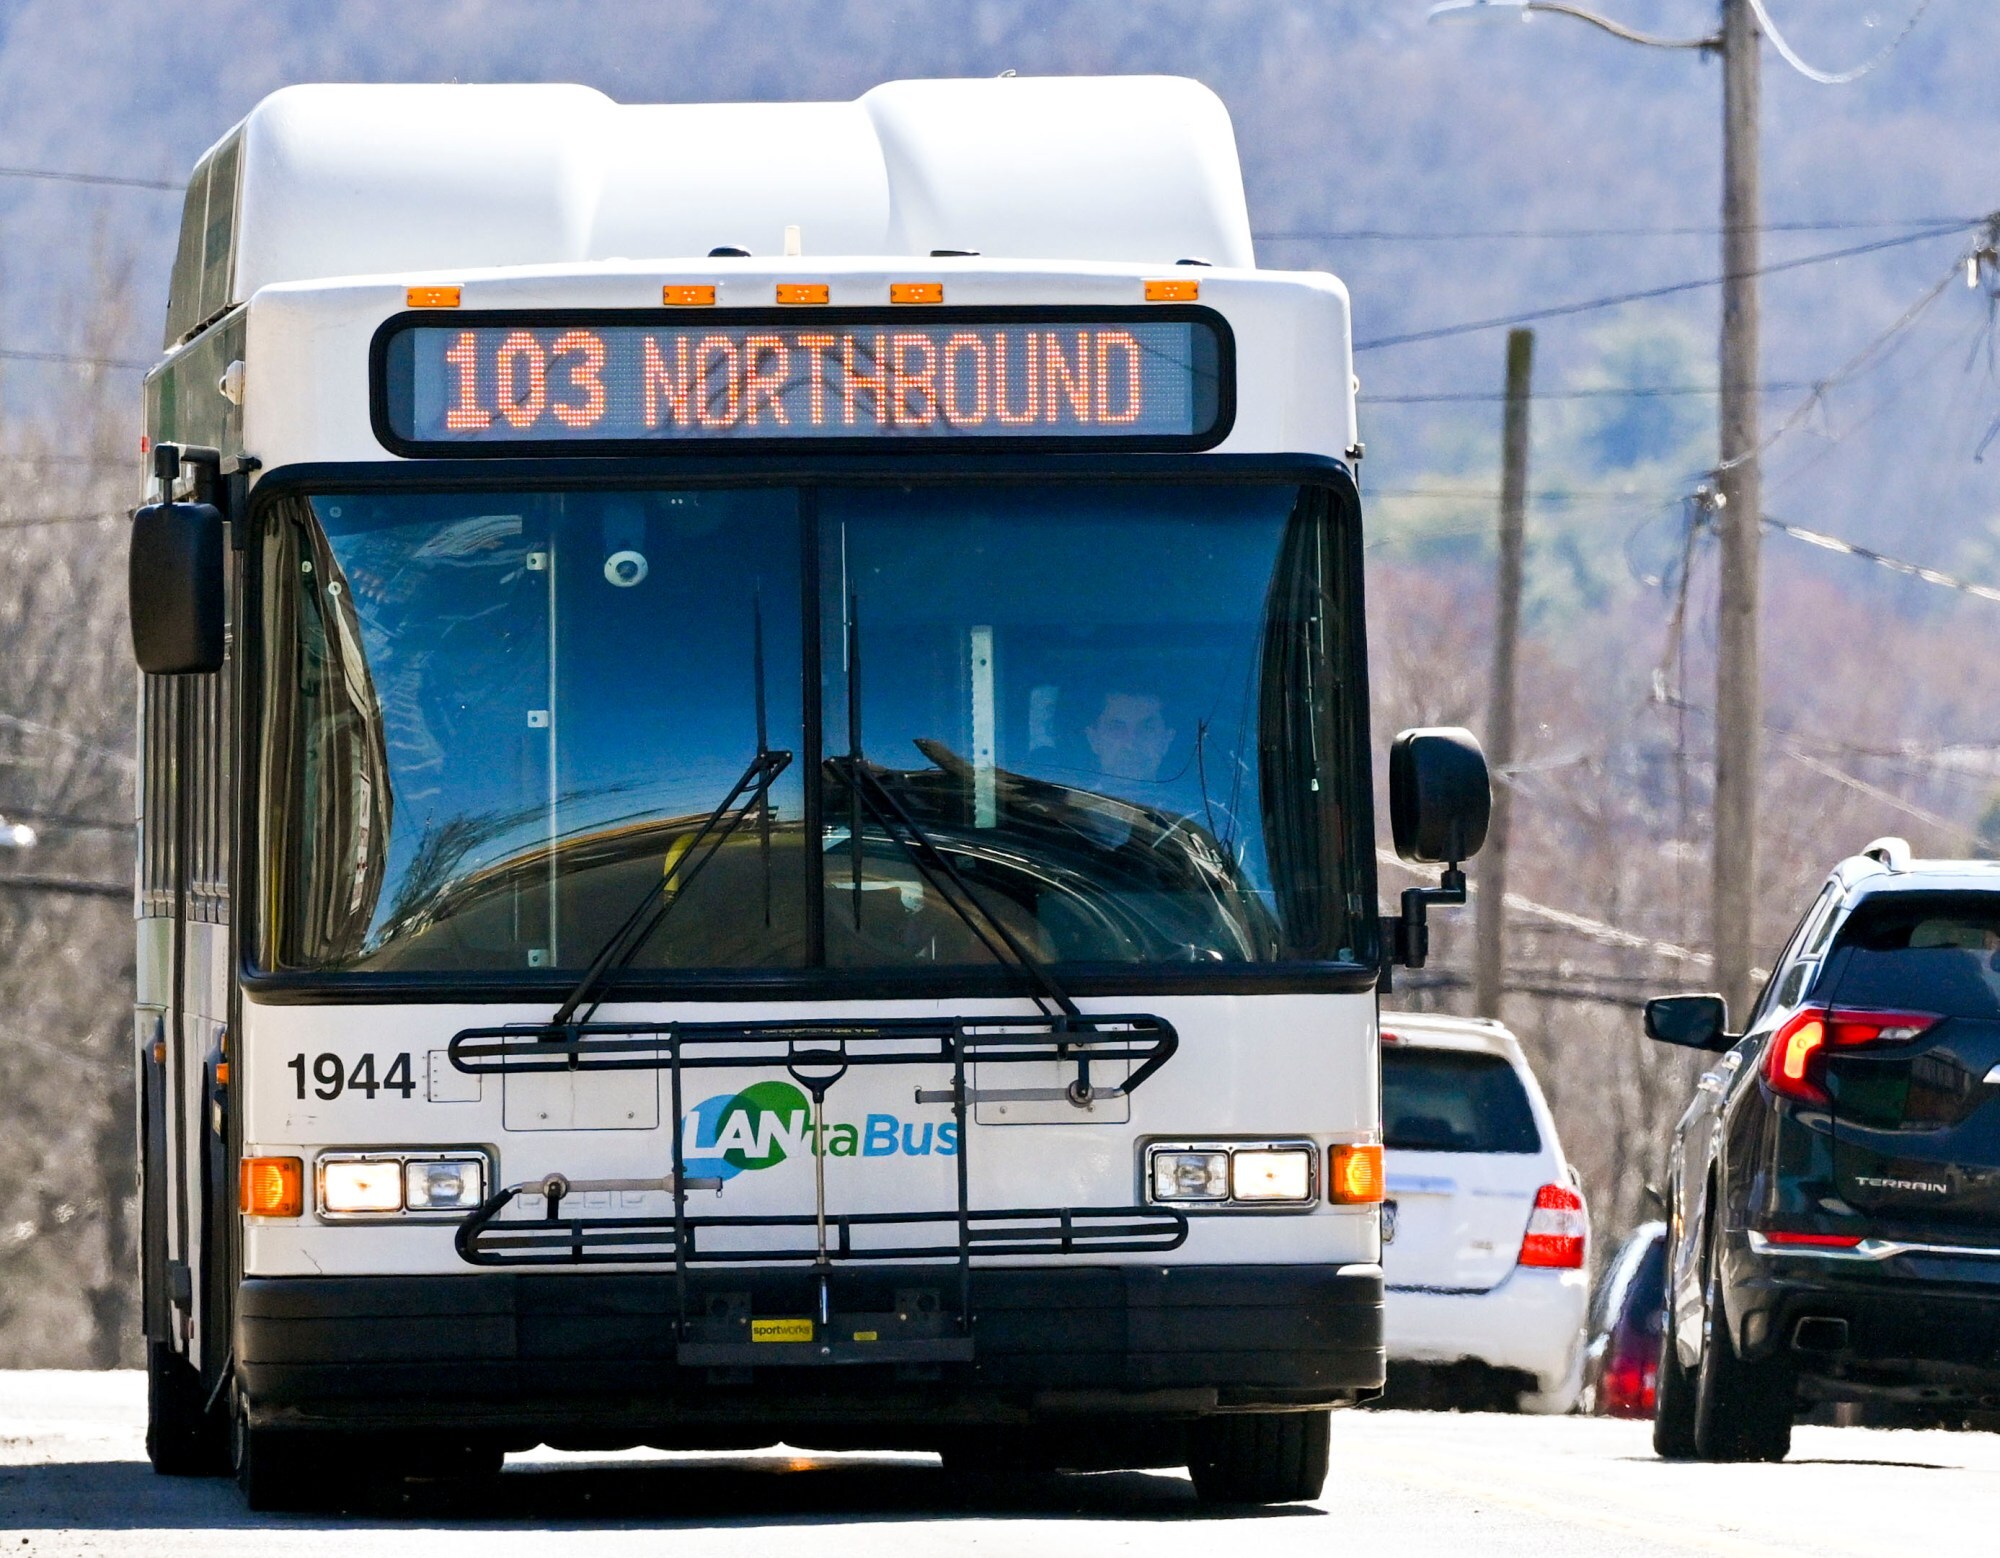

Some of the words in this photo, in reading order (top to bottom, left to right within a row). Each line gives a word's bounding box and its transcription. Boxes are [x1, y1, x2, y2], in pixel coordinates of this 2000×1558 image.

[446, 331, 605, 428] 103
[645, 331, 1140, 427] NORTHBOUND
[287, 1052, 417, 1101] 1944
[1855, 1176, 1947, 1193] TERRAIN
[753, 1325, 810, 1335] sportworks
